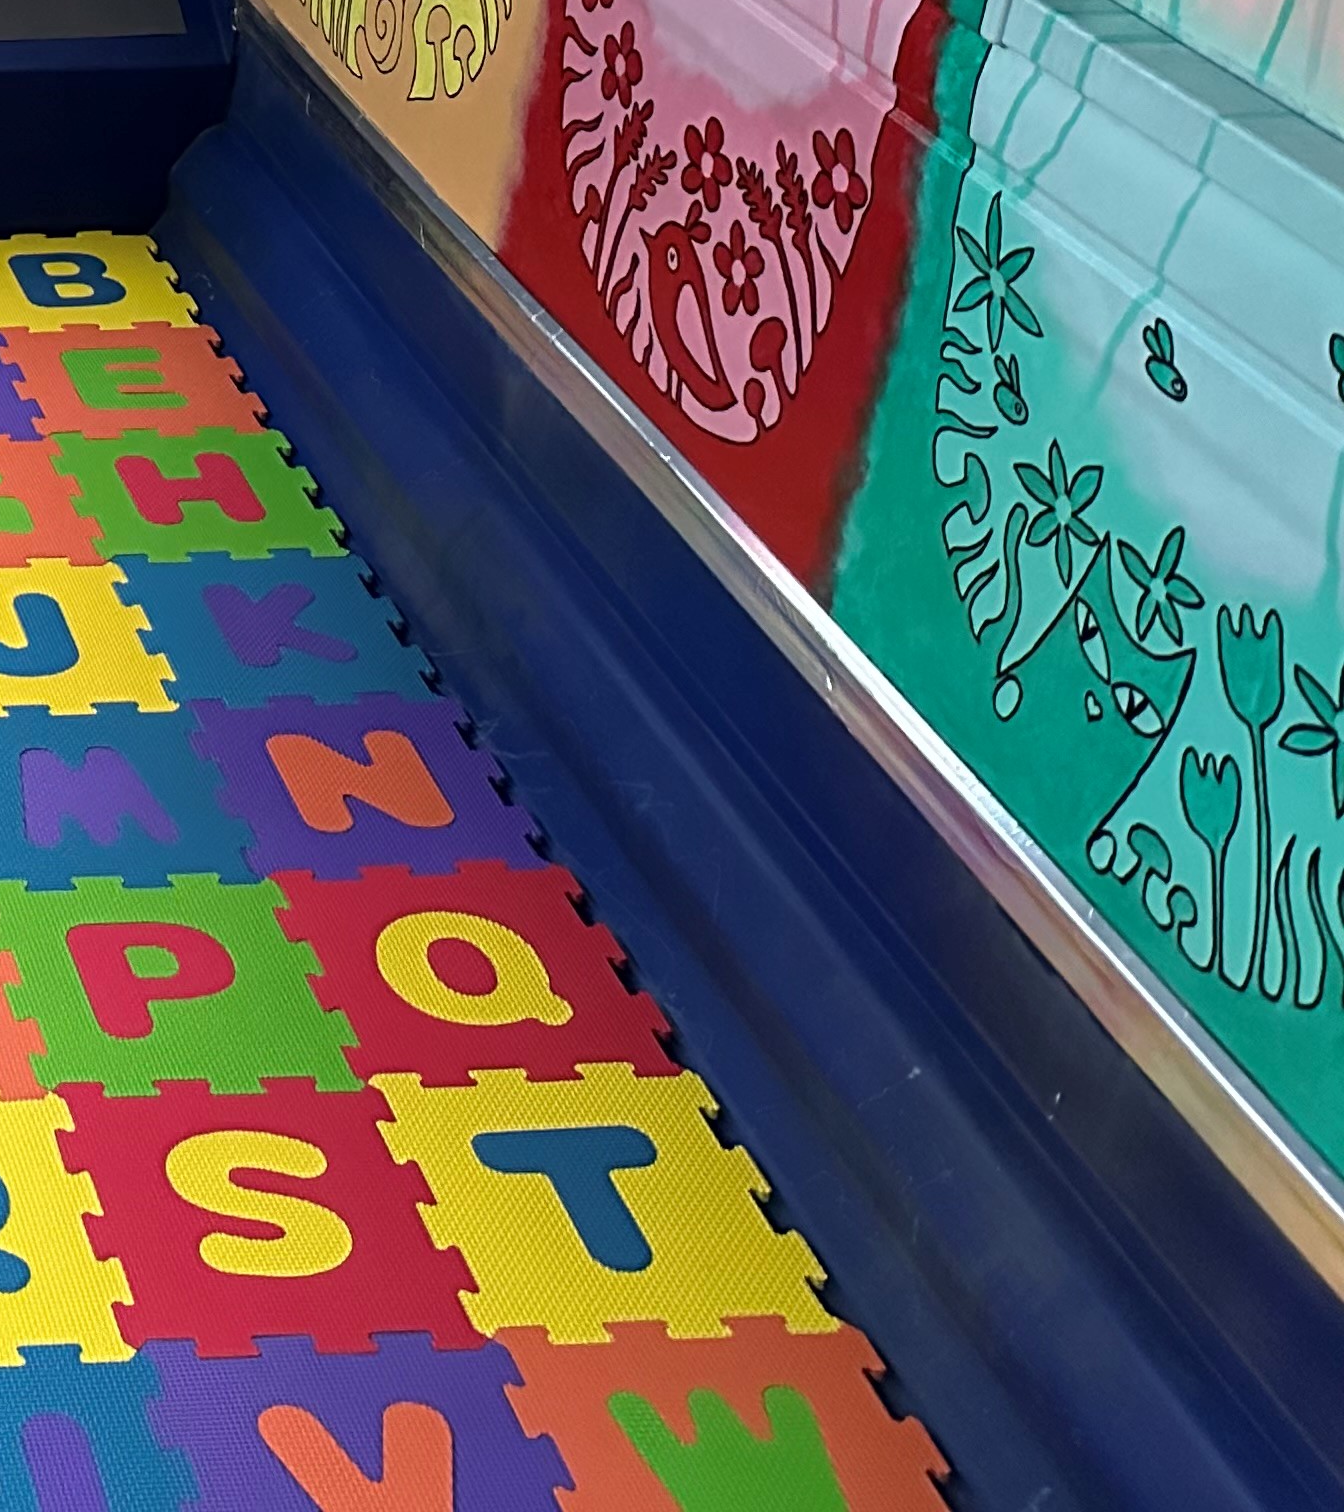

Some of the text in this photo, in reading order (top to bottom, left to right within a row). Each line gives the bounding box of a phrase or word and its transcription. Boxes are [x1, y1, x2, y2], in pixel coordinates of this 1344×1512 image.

[8, 251, 127, 308] B
[59, 346, 189, 411] E
[115, 451, 267, 526] H
[201, 582, 361, 669] K
[19, 745, 181, 848] M
[265, 729, 456, 835] N
[65, 920, 237, 1041] P
[374, 909, 575, 1029] Q
[163, 1128, 354, 1279] S
[470, 1123, 658, 1275] T
